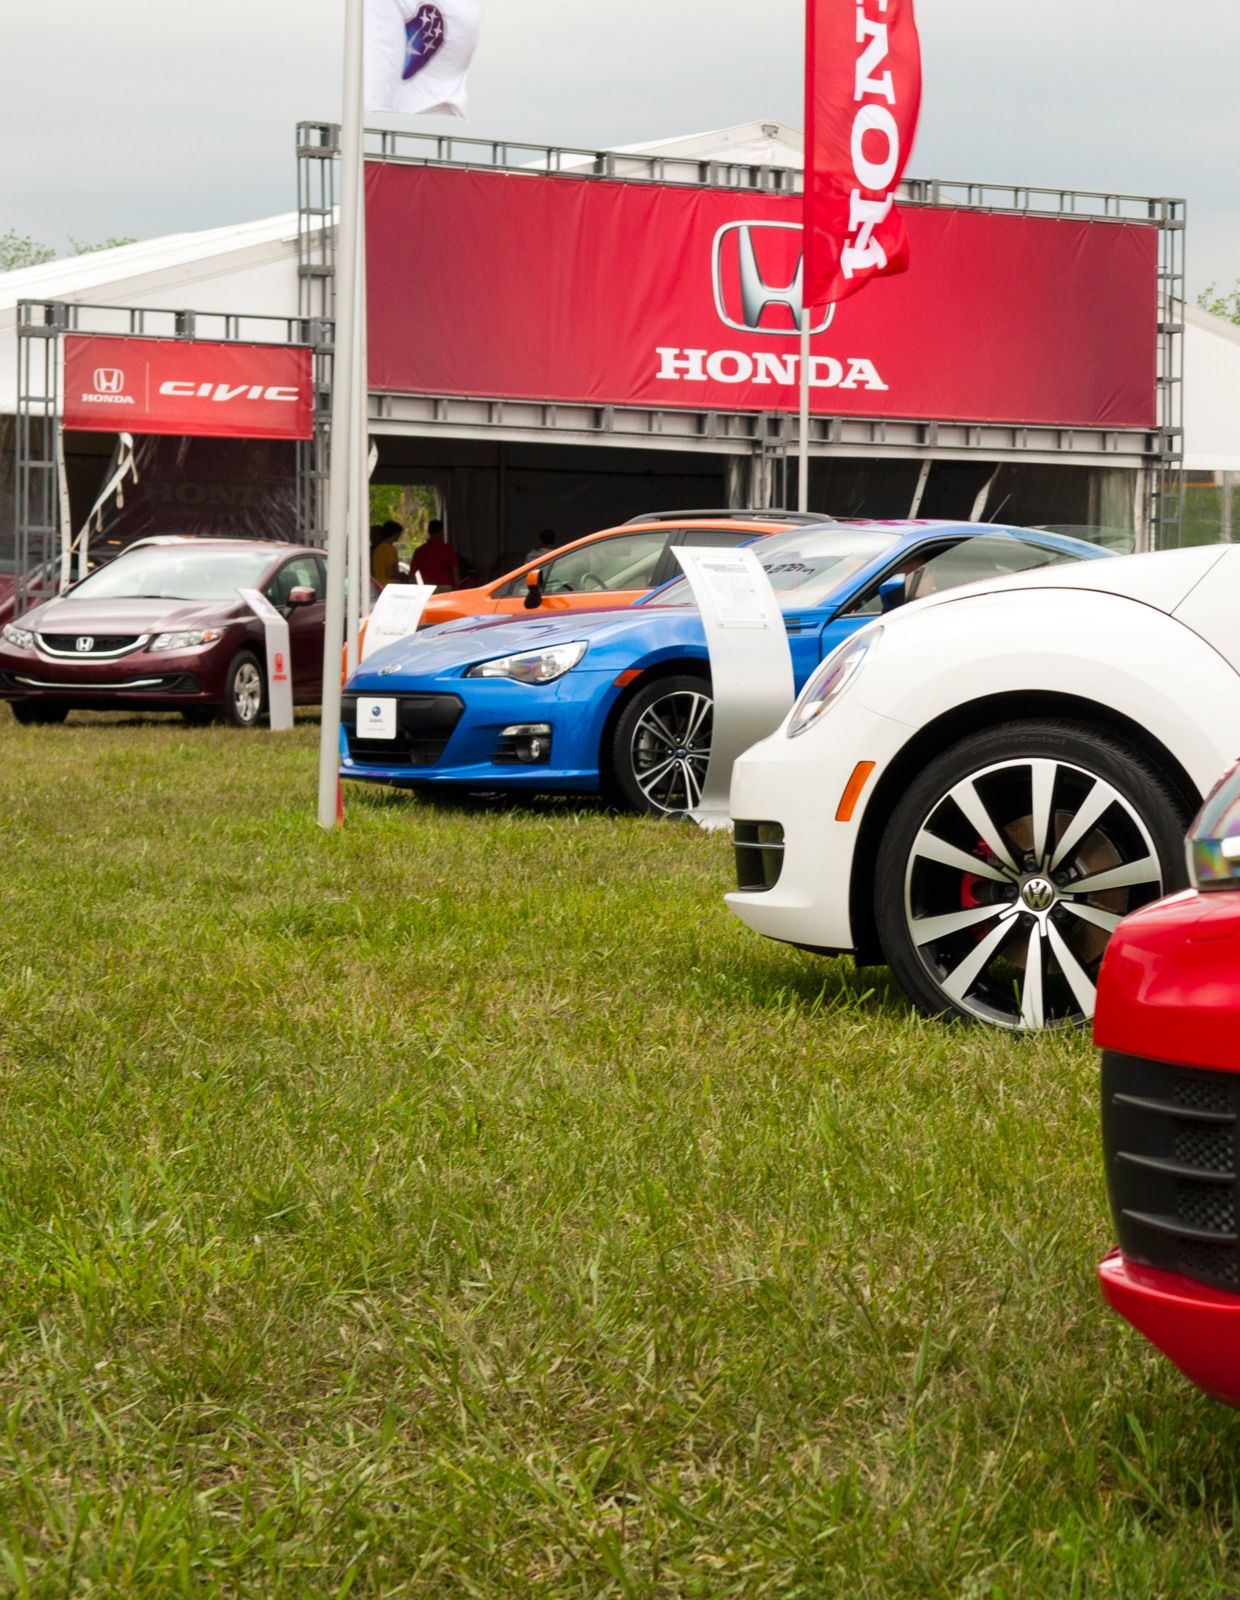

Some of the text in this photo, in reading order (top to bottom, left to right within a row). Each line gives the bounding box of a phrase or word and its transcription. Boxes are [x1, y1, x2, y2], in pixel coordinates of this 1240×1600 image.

[840, 0, 899, 279] HON
[656, 347, 888, 391] HONDA
[81, 393, 135, 404] HONDA
[159, 381, 299, 401] CIVIC
[144, 481, 284, 507] HOND
[1022, 878, 1053, 911] VW
